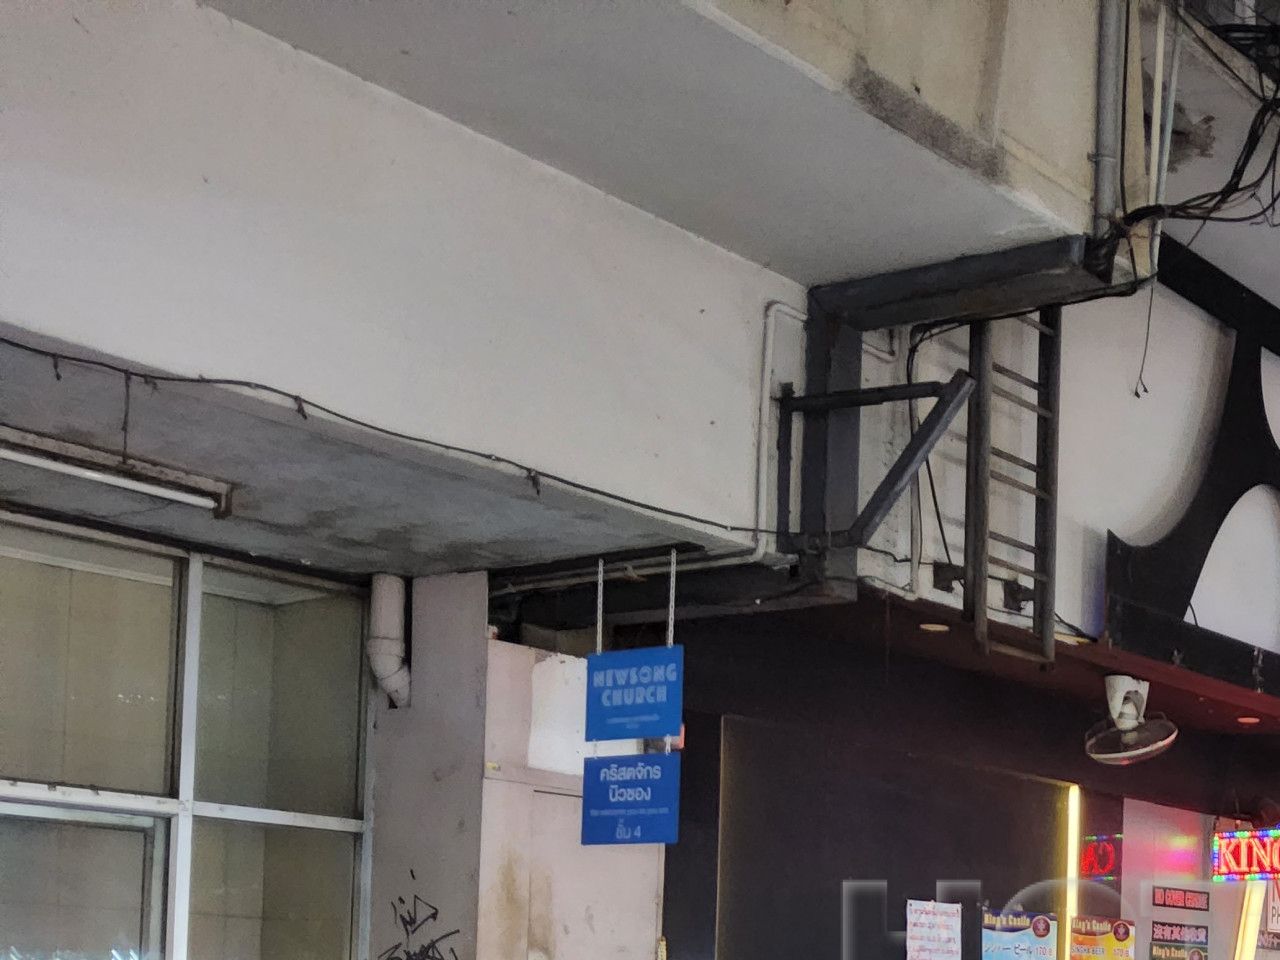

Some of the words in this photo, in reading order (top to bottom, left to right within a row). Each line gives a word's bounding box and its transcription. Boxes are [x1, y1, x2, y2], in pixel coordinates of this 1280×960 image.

[593, 663, 677, 688] NEWSONG
[601, 685, 667, 707] CHURCH
[633, 825, 642, 838] 4
